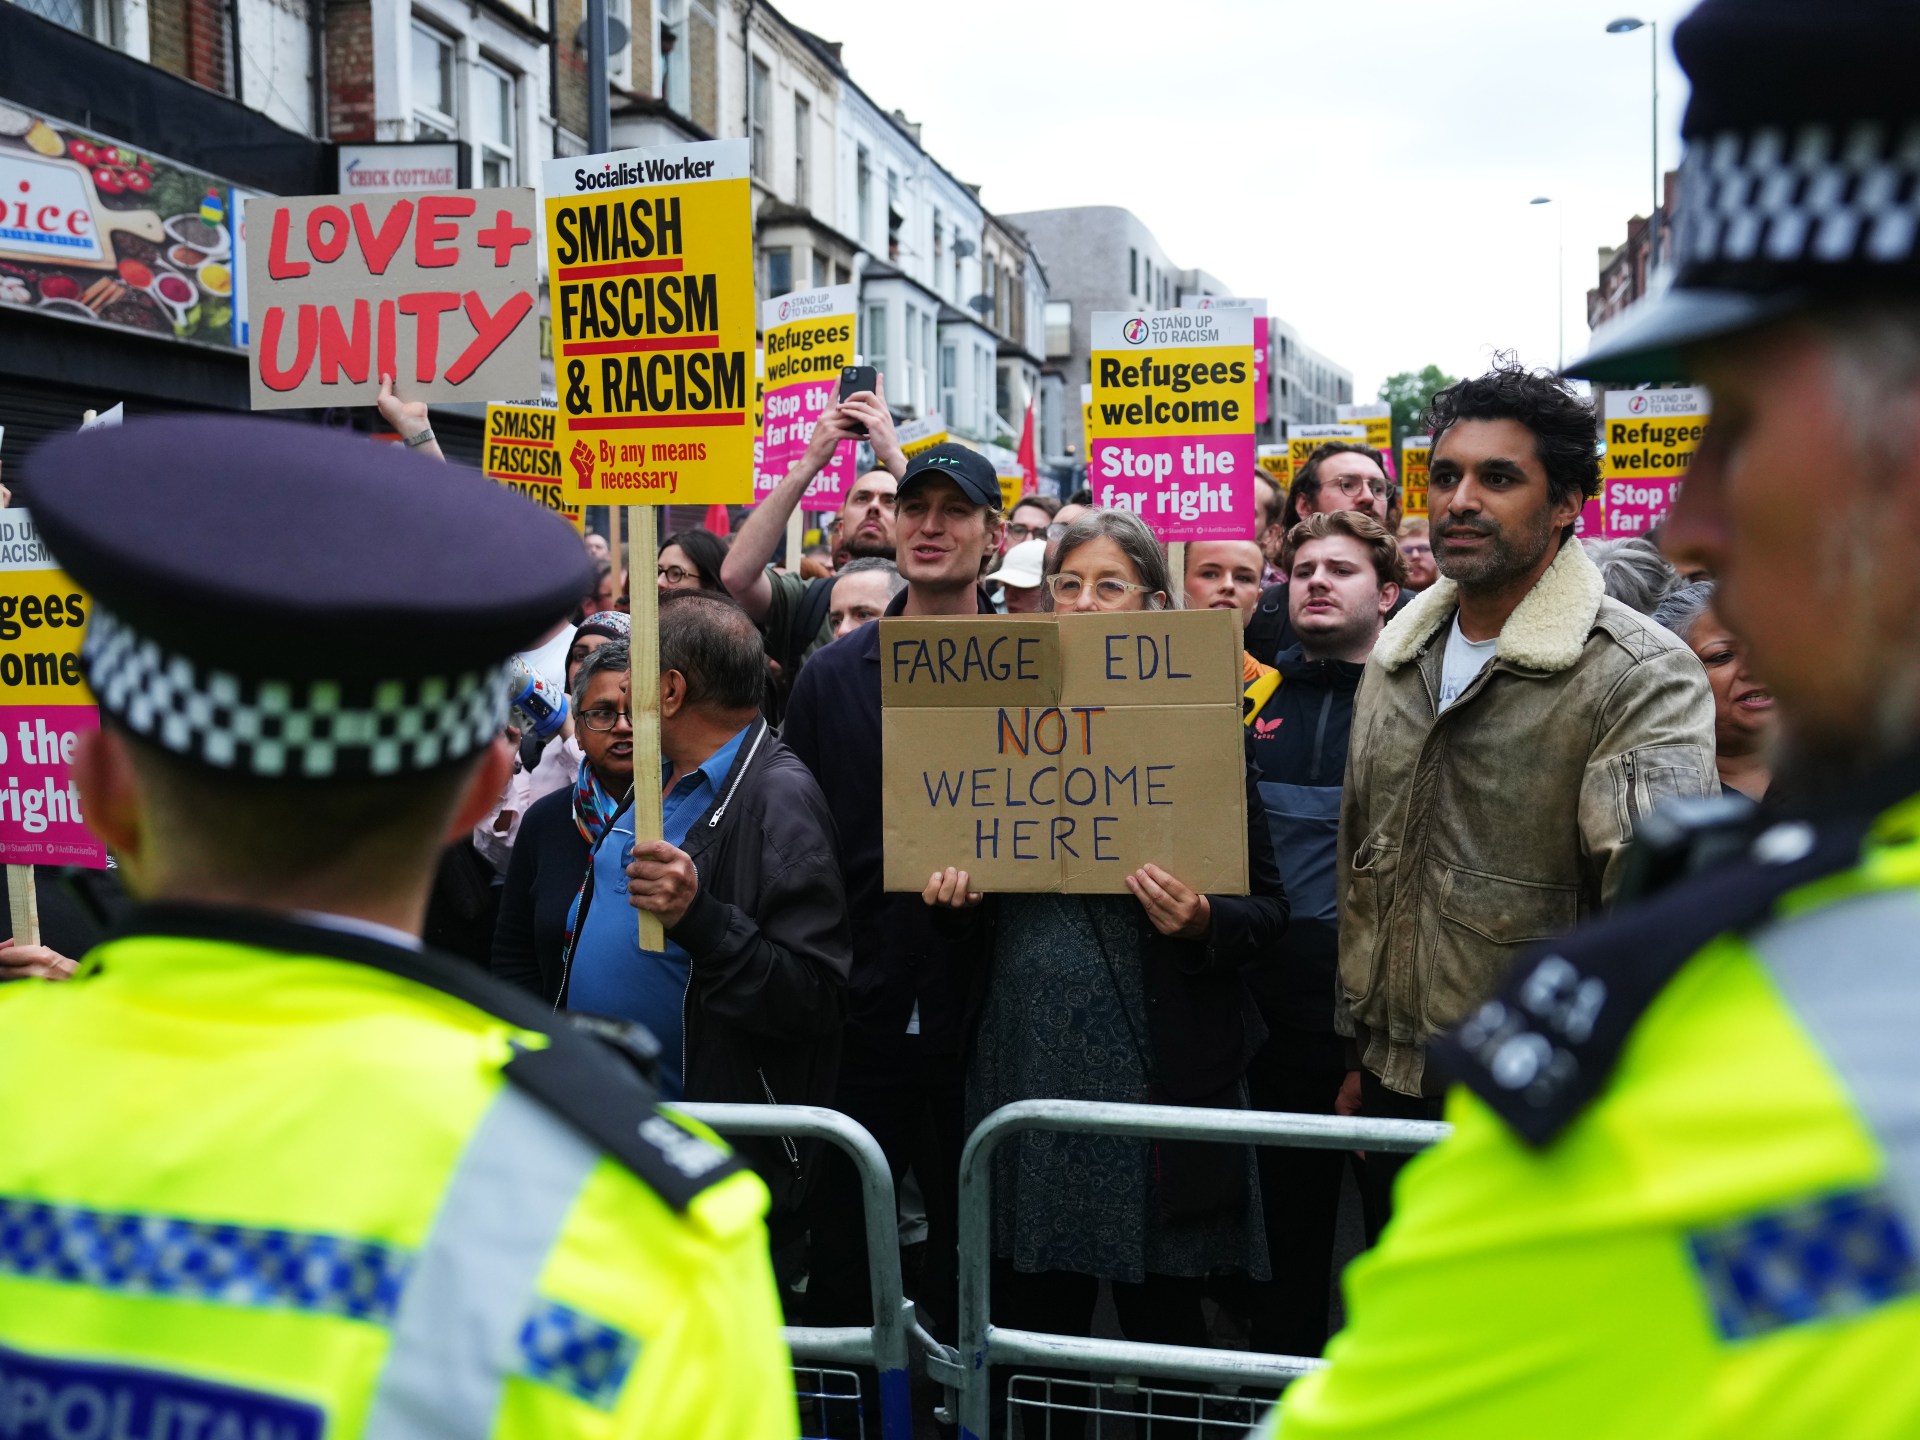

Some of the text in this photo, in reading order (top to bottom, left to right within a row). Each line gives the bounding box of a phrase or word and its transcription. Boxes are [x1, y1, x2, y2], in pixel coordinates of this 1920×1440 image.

[393, 168, 453, 185] COTTAGE
[575, 157, 714, 191] Socialist Worker
[556, 197, 682, 265] SMASH
[560, 274, 719, 340] FASCISM
[792, 294, 830, 307] STAND UP
[792, 304, 833, 317] TO RACISM
[1152, 315, 1212, 330] STAND UP
[1152, 329, 1219, 343] TO RACISM
[259, 291, 535, 391] UNITY
[768, 325, 850, 355] Refugees
[768, 354, 844, 381] welcome
[1101, 357, 1246, 393] Refugees
[566, 352, 745, 415] & RACISM
[767, 387, 829, 419] Stop th
[1101, 395, 1239, 425] welcome
[491, 410, 556, 440] SMASH
[767, 424, 788, 447] far
[599, 440, 706, 467] By any means
[1101, 444, 1235, 483] Stop the
[601, 471, 678, 493] necessary
[1611, 483, 1662, 509] Stop
[1101, 482, 1233, 520] far right
[1610, 509, 1643, 531] far
[0, 544, 51, 563] ACISM
[894, 635, 1191, 684] FARAGE EDL
[18, 718, 79, 764] the
[998, 706, 1105, 758] NOT
[923, 765, 1175, 807] WELCOME
[976, 817, 1119, 860] HERE
